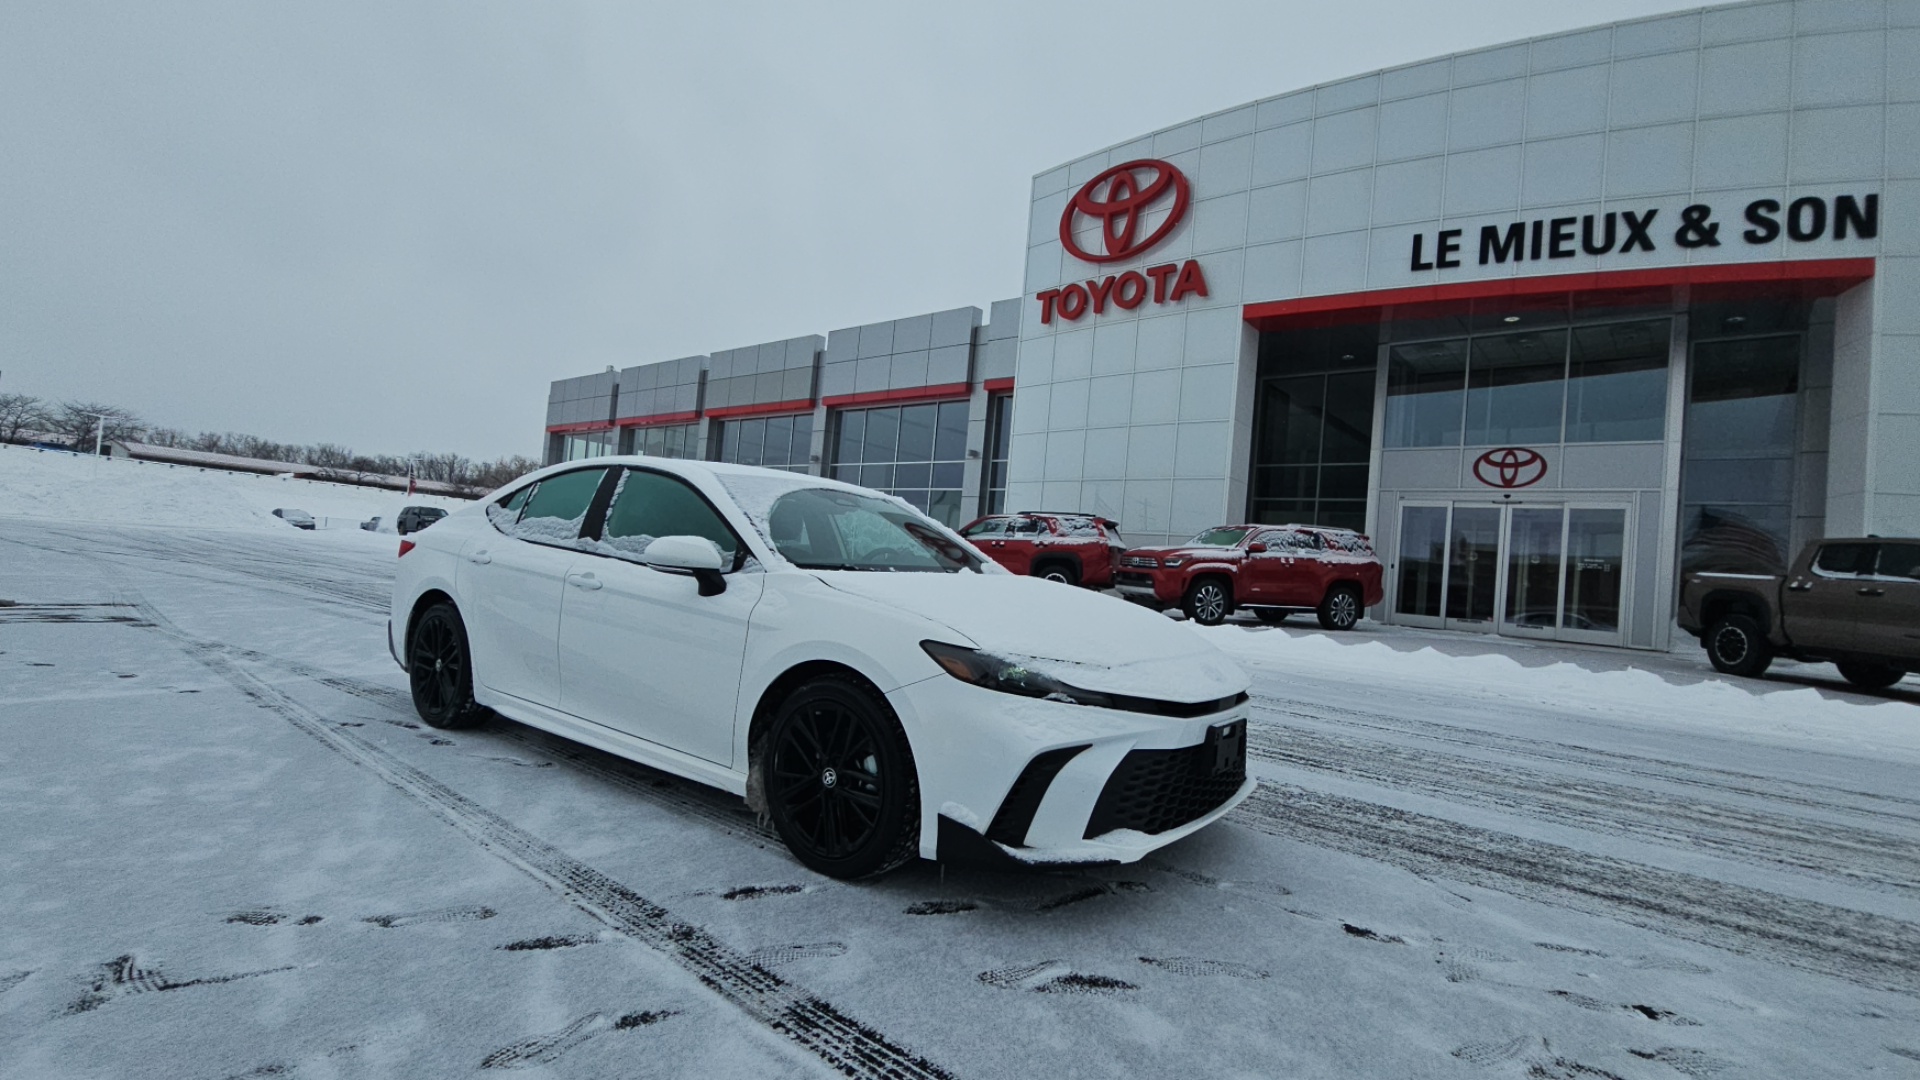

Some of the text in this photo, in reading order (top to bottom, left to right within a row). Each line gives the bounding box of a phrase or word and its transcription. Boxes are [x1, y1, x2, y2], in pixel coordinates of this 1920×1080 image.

[1410, 193, 1879, 272] LE MIEUX & SON
[1036, 259, 1208, 324] TOYOTA
